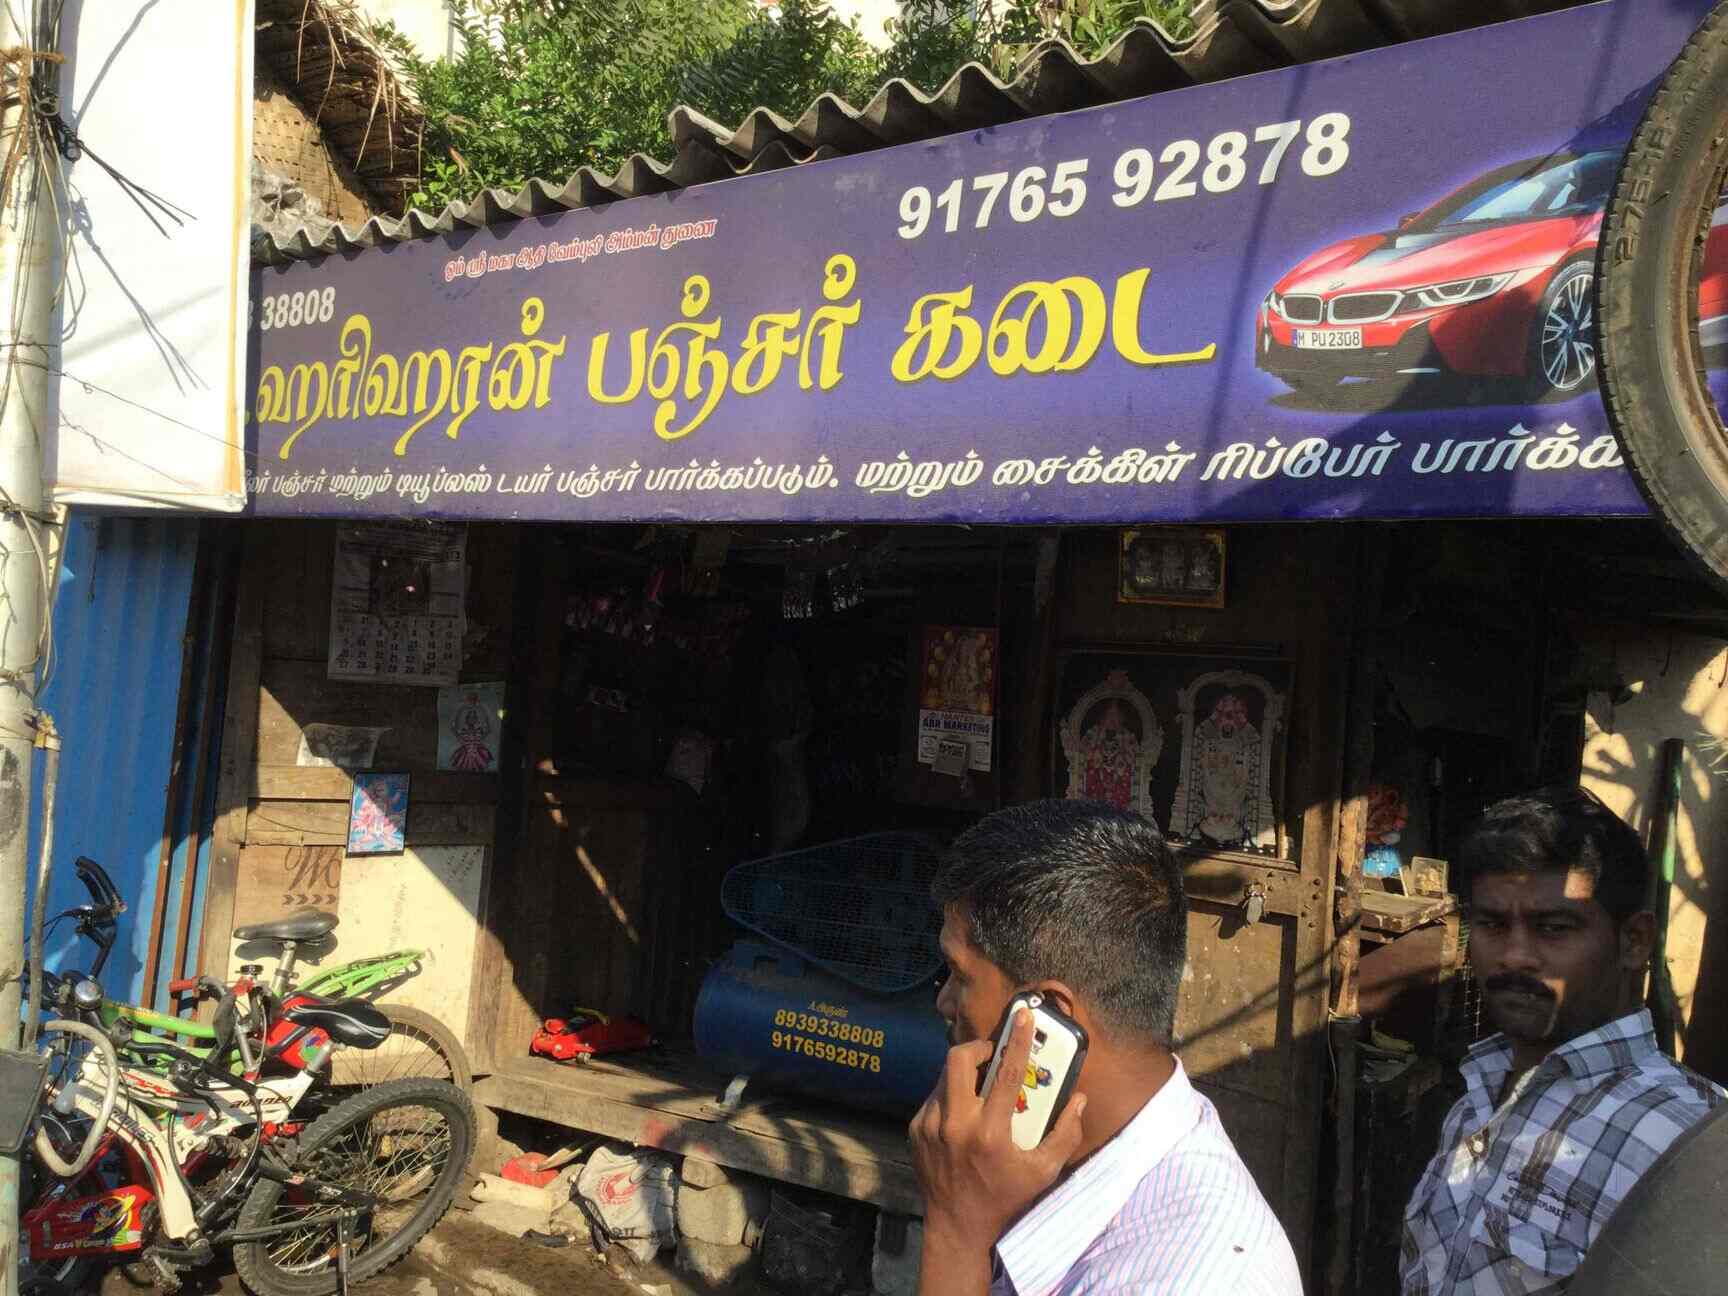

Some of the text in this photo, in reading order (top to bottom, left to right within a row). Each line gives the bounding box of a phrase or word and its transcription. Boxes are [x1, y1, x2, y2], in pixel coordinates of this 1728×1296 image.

[897, 112, 1351, 240] 91765 92878
[259, 286, 337, 331] 38808
[255, 253, 1217, 460] ஹரிஹரன் பஞ்சர் கடை
[272, 467, 328, 498] பஞ்சர்
[329, 466, 393, 500] மற்றும்
[496, 463, 553, 494] டயர்
[556, 459, 642, 498] பஞ்சர்
[644, 454, 840, 495] பார்க்கப்படும்.
[855, 447, 984, 498] மற்றும்
[991, 438, 1197, 488] சைக்கிள்
[1200, 430, 1402, 480] ரிப்பேர்
[771, 1030, 881, 1073] 9176592878
[774, 1008, 885, 1049] 8939338808
